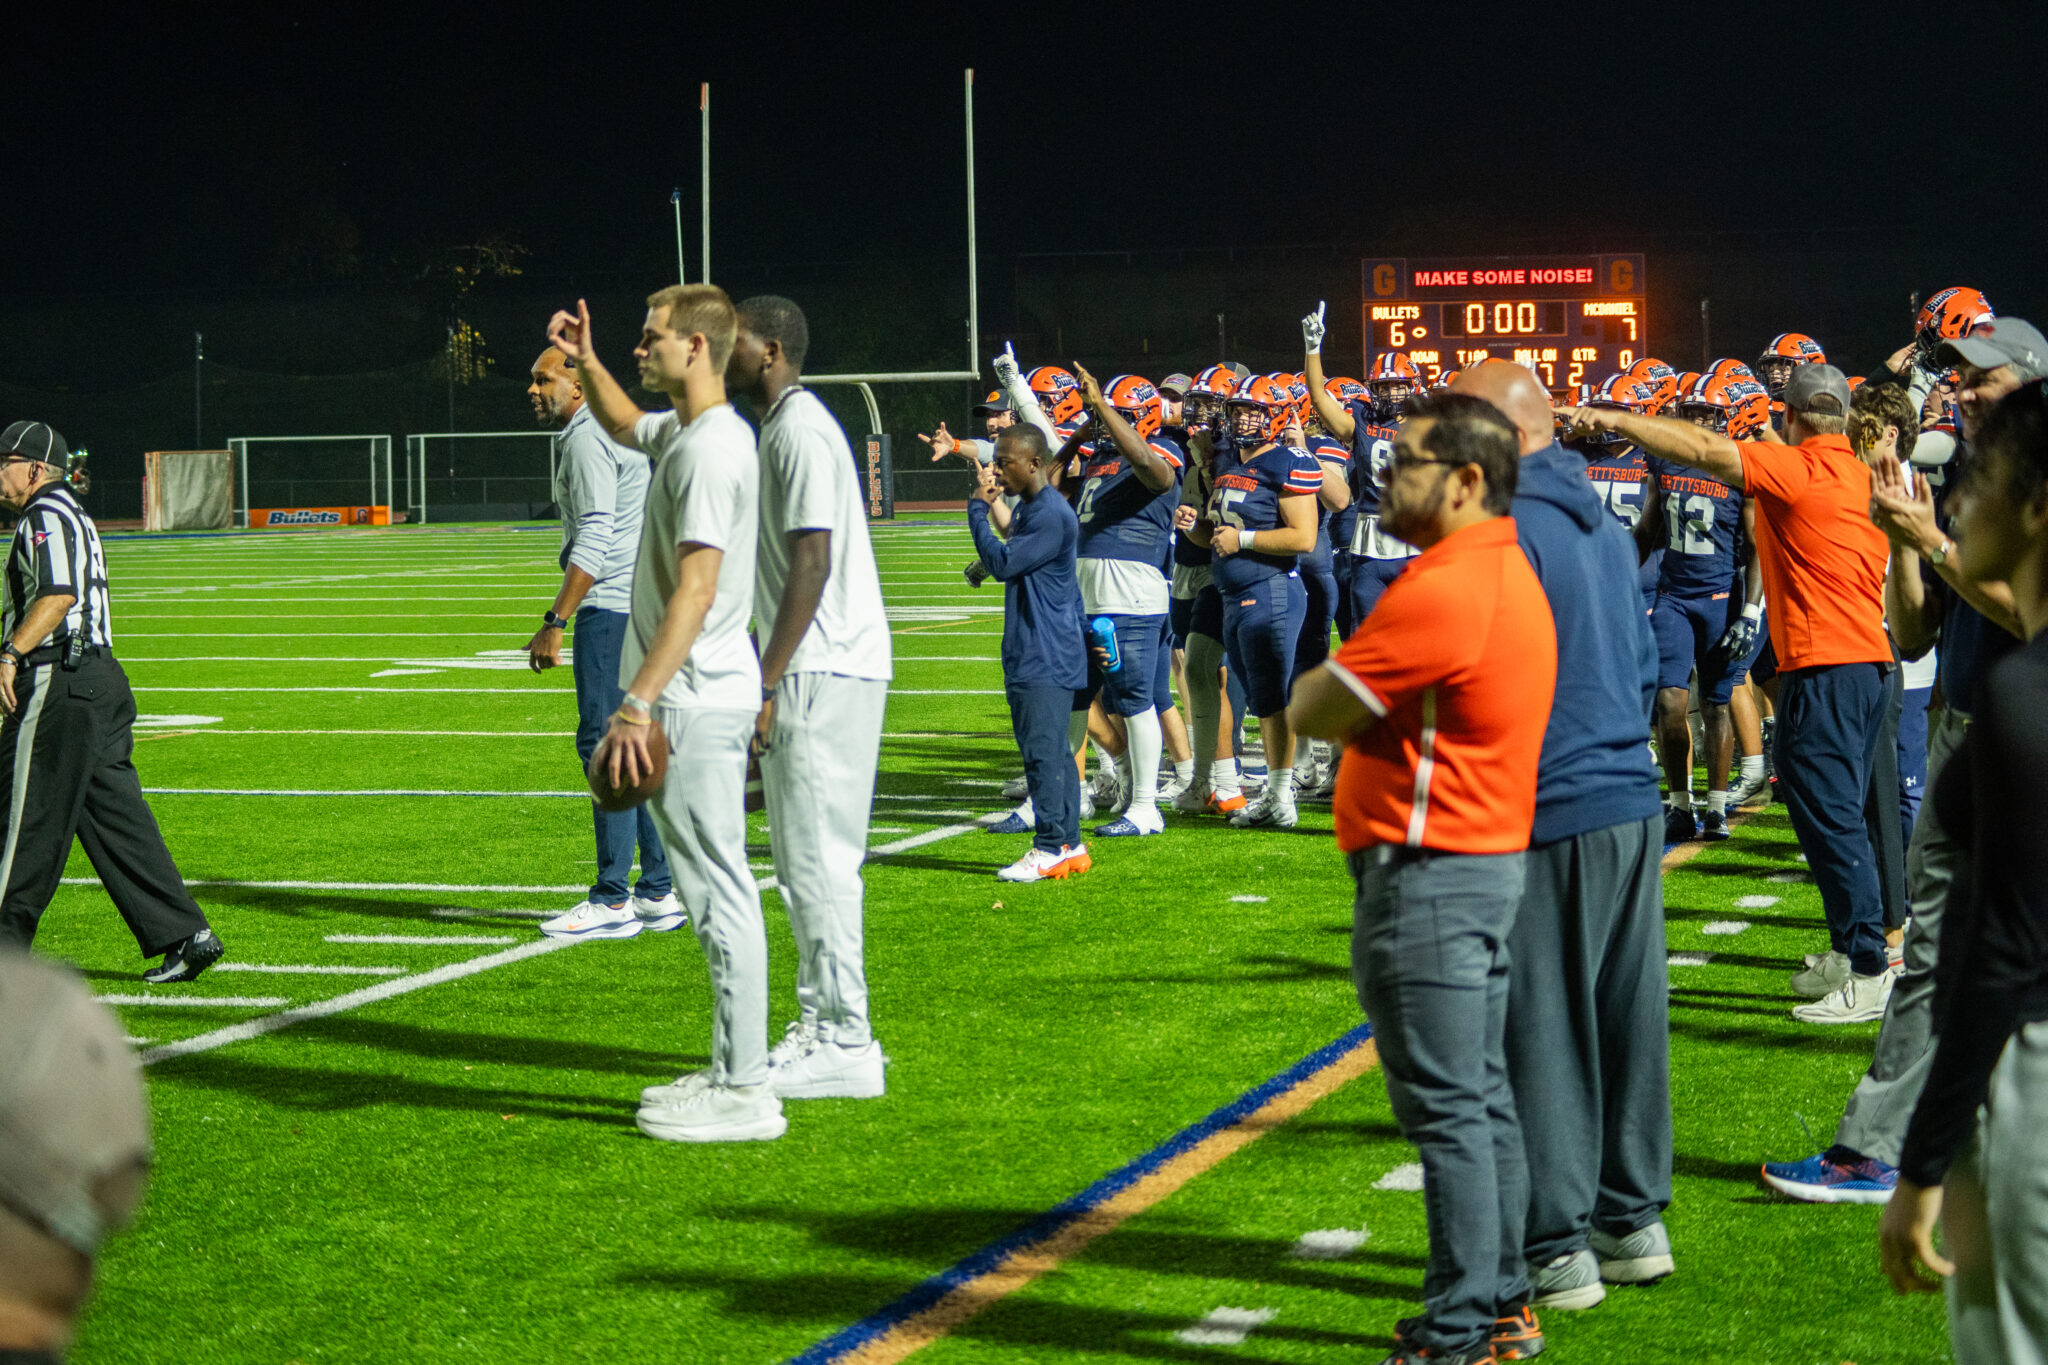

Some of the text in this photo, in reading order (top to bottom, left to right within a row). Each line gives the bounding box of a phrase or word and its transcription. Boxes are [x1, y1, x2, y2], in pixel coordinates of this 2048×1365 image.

[1373, 264, 1396, 296] G
[1414, 267, 1594, 287] MAKE SOME NOISE!
[1610, 259, 1634, 292] G
[1371, 305, 1421, 321] BULLETS
[1390, 321, 1406, 347] 6
[1621, 317, 1637, 341] 7
[1572, 346, 1597, 362] QTR
[1568, 361, 1584, 387] 2
[1365, 423, 1398, 441] GETTY
[867, 441, 882, 516] BULLETS
[1585, 465, 1649, 482] ETTYSBUR
[1660, 474, 1729, 499] GETTYSBURG
[267, 510, 341, 525] Bullets
[1665, 491, 1715, 555] 12
